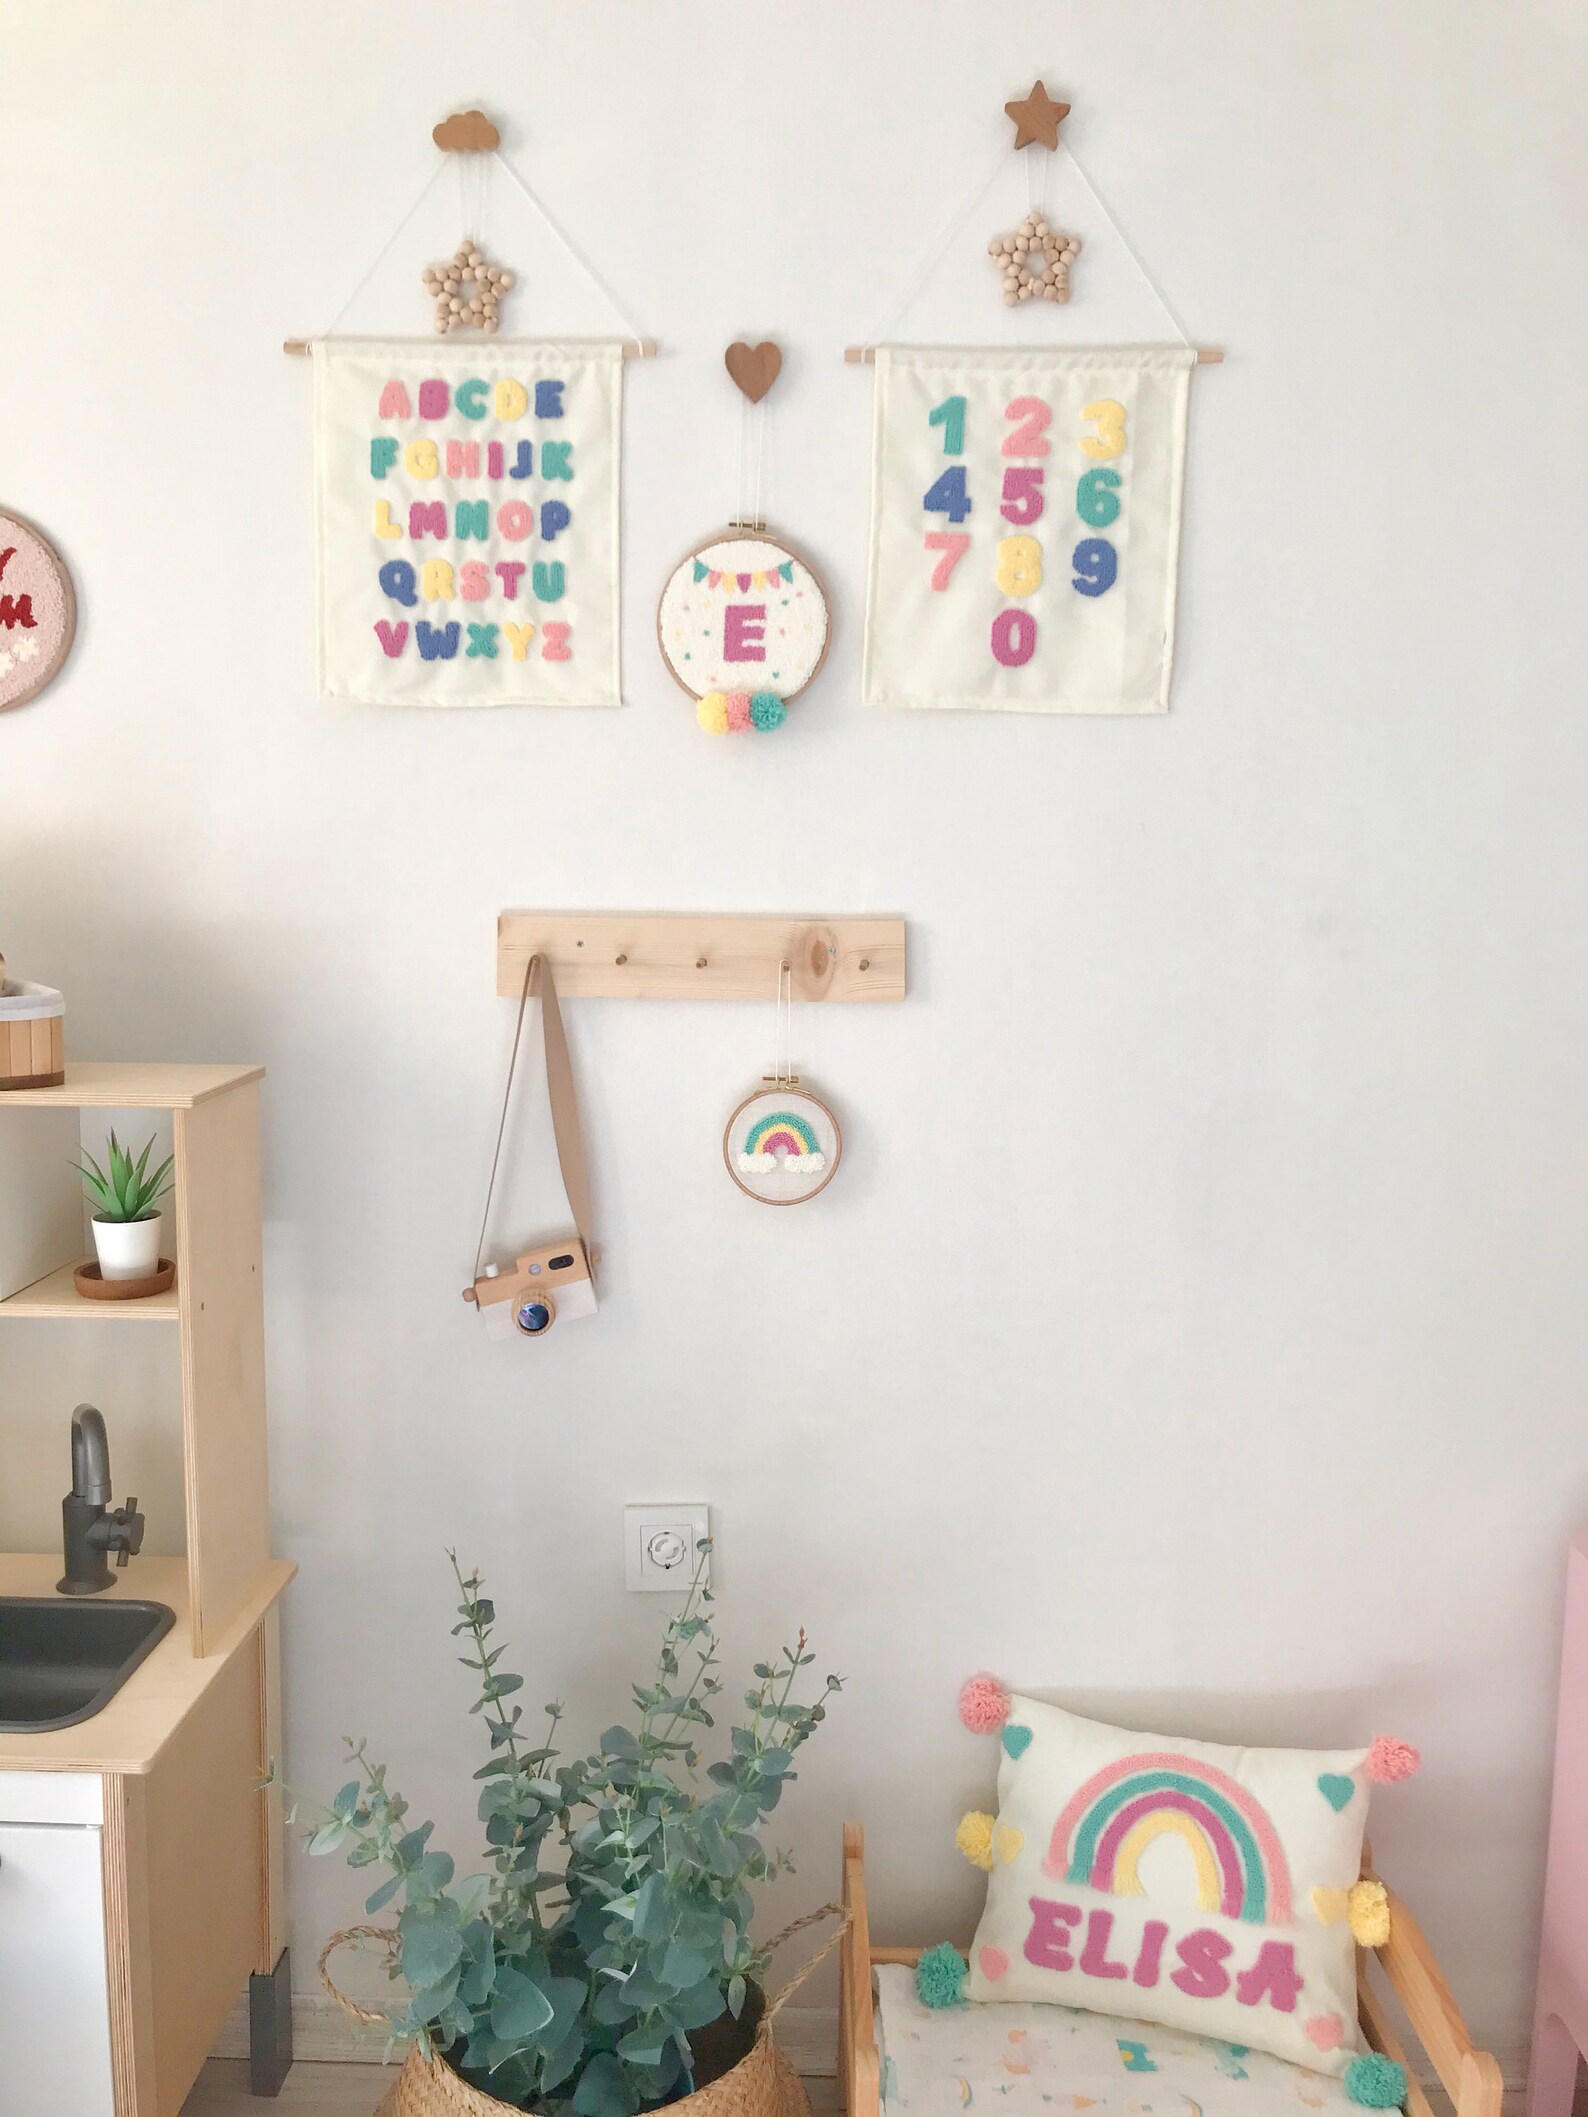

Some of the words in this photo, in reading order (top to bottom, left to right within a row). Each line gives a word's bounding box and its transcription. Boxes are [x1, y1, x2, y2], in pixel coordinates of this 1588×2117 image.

[928, 395, 968, 455] 1
[1000, 395, 1054, 457] 2
[1078, 399, 1128, 460] 3
[923, 465, 972, 523] 4
[1000, 467, 1045, 526] 5
[1075, 467, 1123, 529] 6
[923, 531, 971, 592] 7
[995, 534, 1043, 597] 8
[1071, 538, 1118, 598] 9
[723, 603, 767, 663] E
[1022, 1894, 1305, 2014] ELISA
